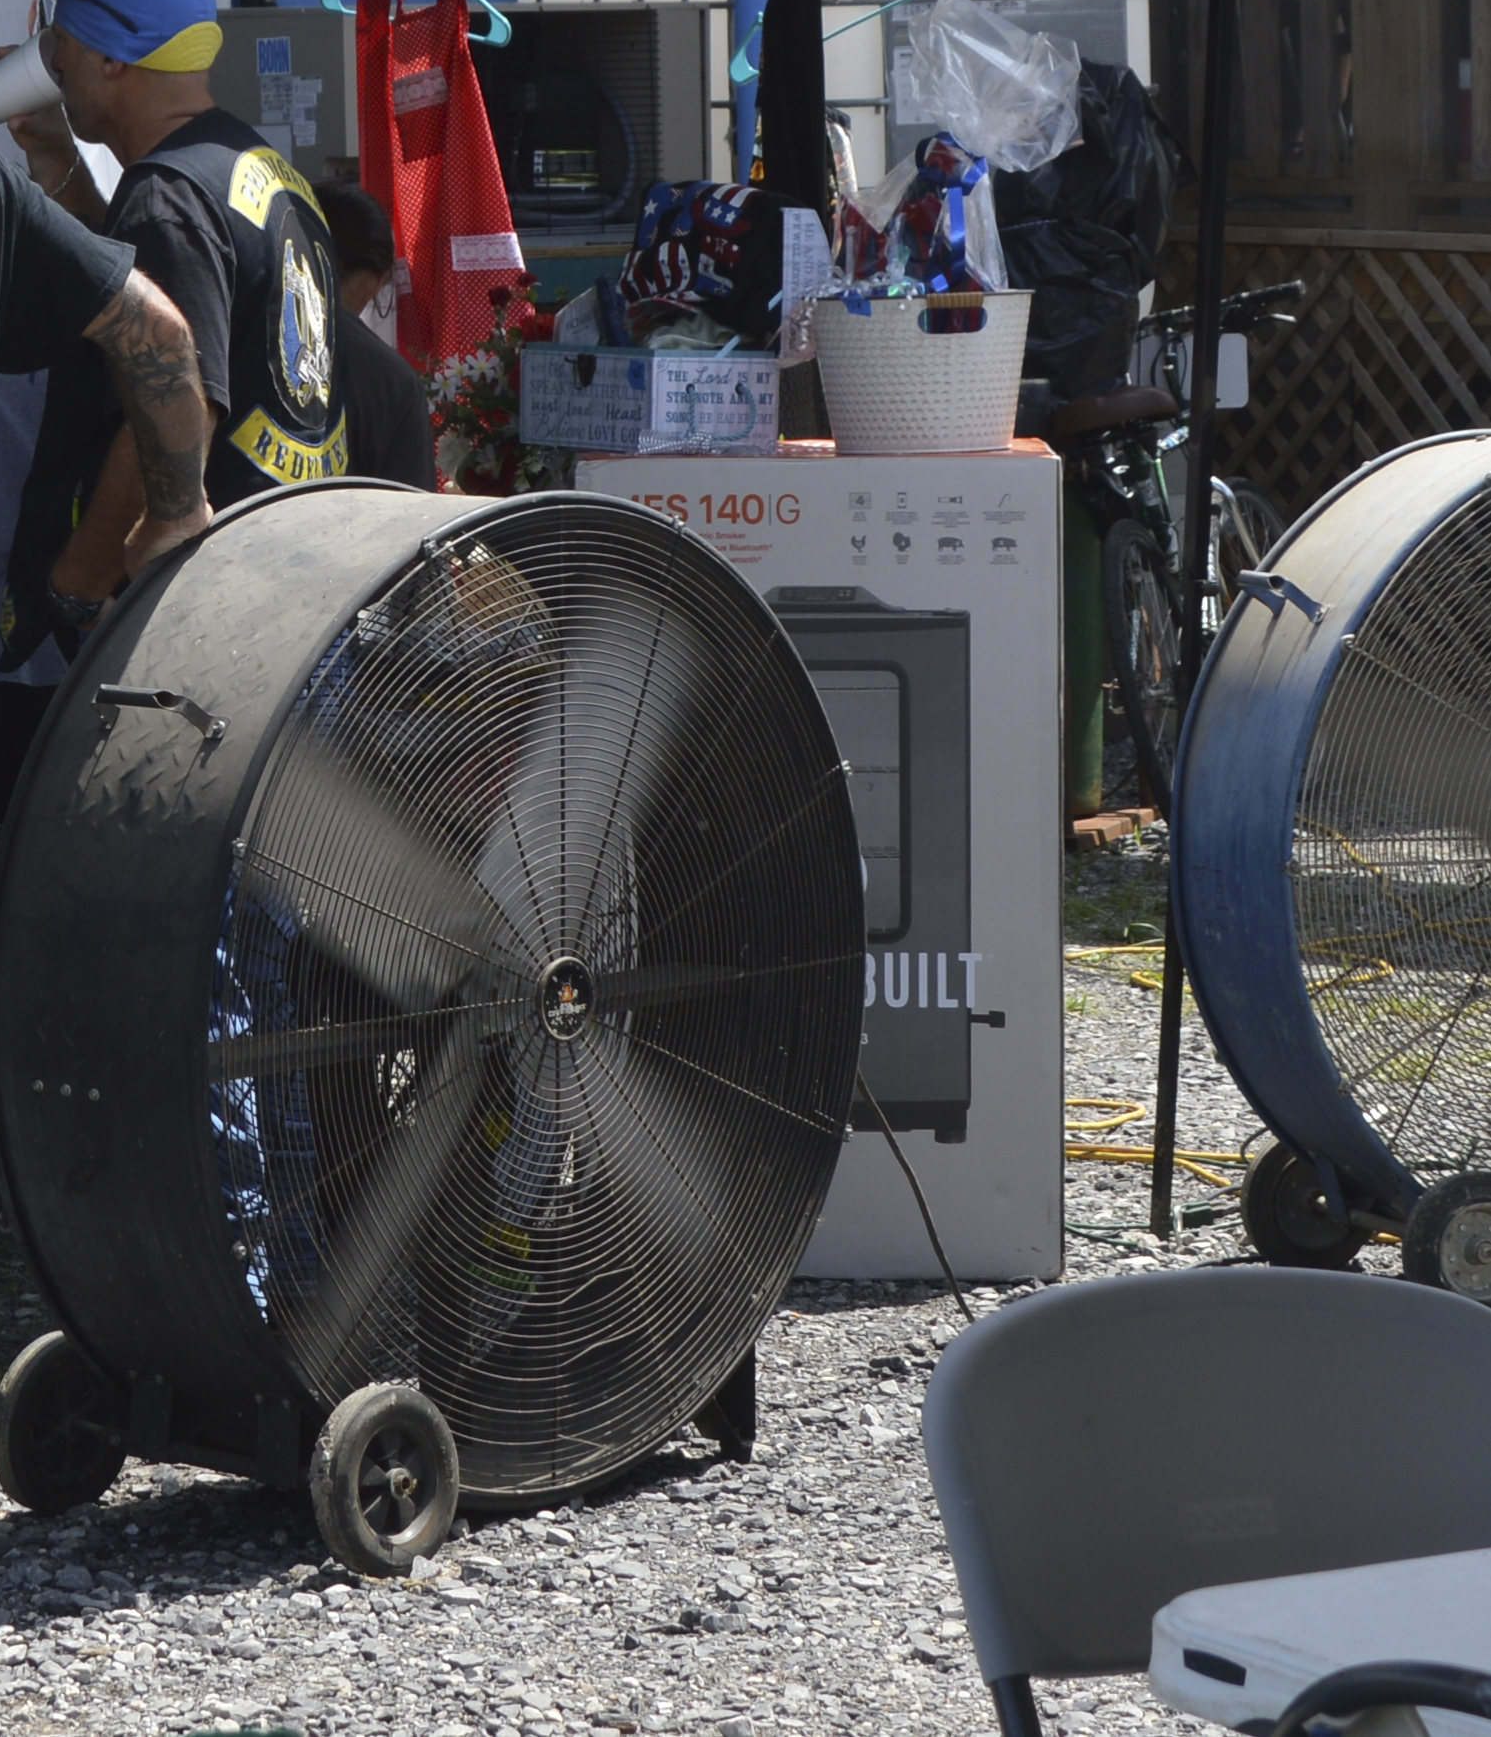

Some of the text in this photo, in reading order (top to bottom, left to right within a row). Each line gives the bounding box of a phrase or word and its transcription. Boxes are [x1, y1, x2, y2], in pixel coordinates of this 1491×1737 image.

[668, 370, 688, 383] THE
[693, 367, 731, 385] Lord
[756, 372, 772, 384] MY
[666, 392, 724, 405] STRNGTH
[758, 392, 774, 405] MY
[699, 413, 714, 424] HE
[718, 413, 735, 425] HAS
[737, 413, 775, 425] BEME
[588, 424, 617, 441] LOVE
